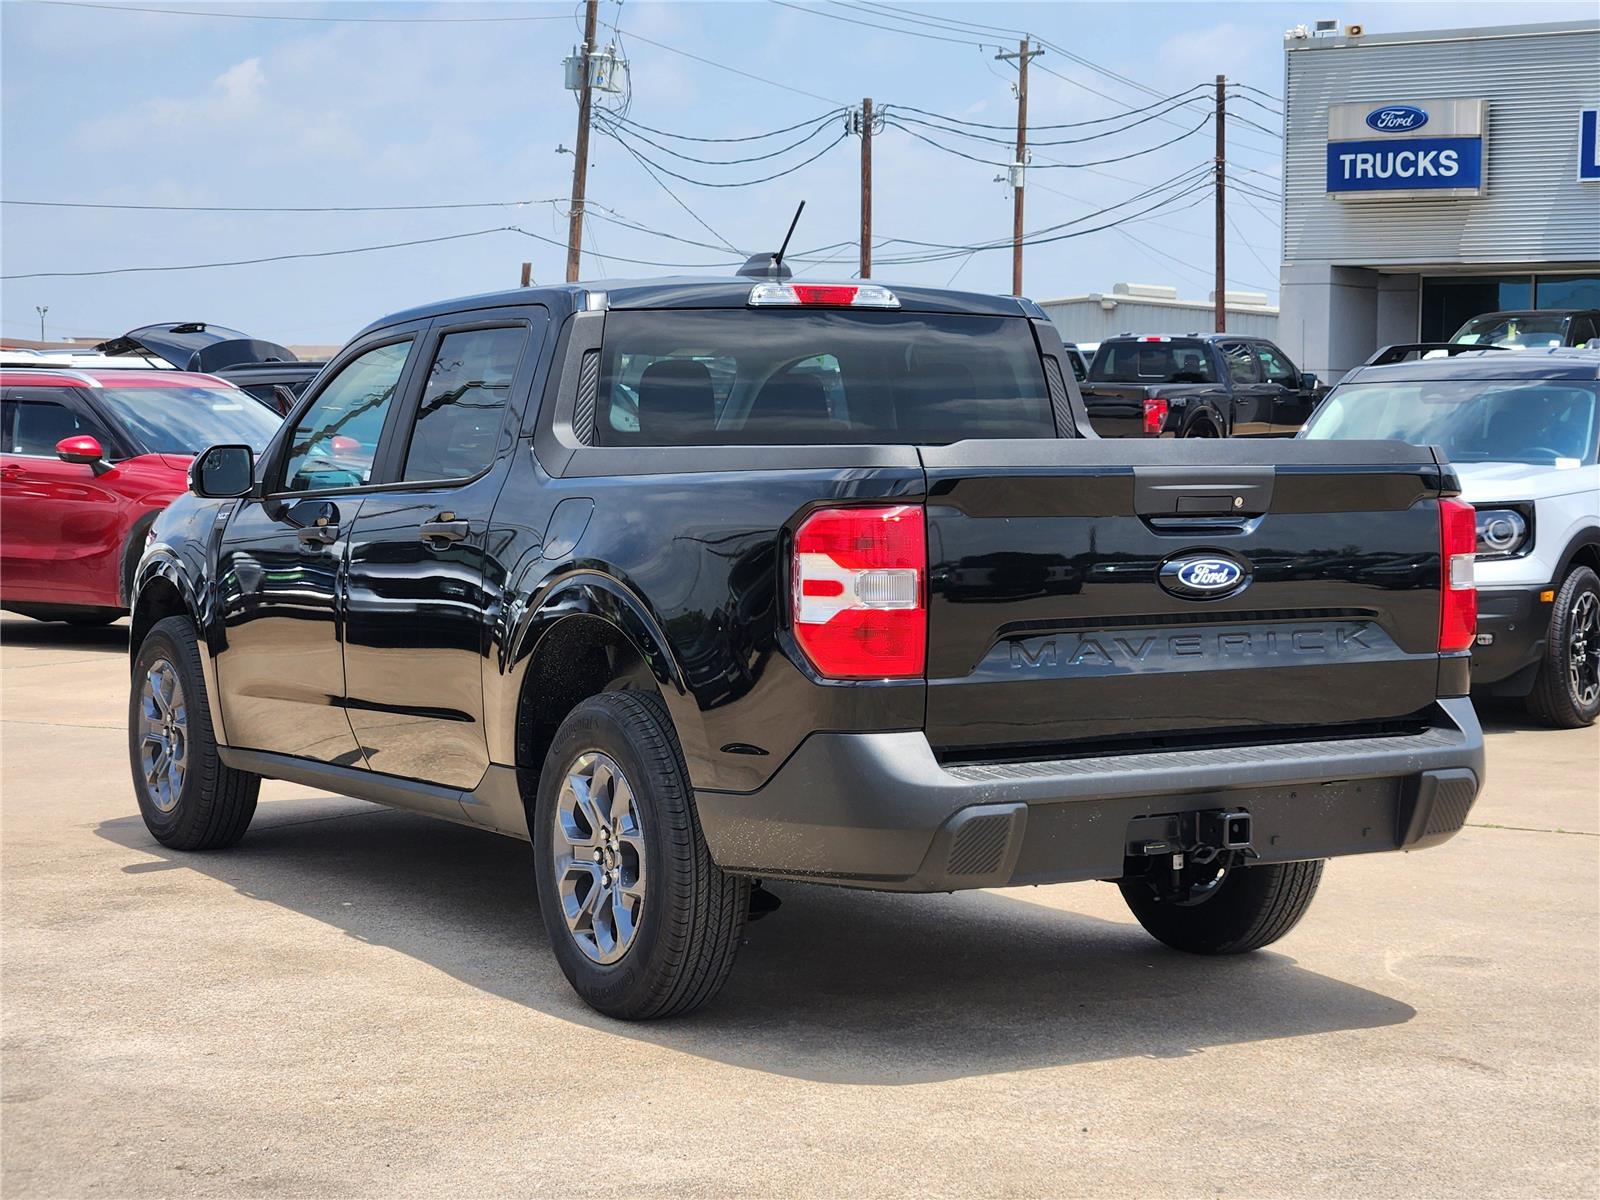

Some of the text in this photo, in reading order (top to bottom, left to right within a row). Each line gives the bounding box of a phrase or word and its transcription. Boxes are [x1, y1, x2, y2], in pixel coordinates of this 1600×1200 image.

[1377, 110, 1415, 128] Ford
[1339, 149, 1460, 180] TRUCKS
[1190, 563, 1229, 584] Ford
[1009, 626, 1372, 669] MAVERICK
